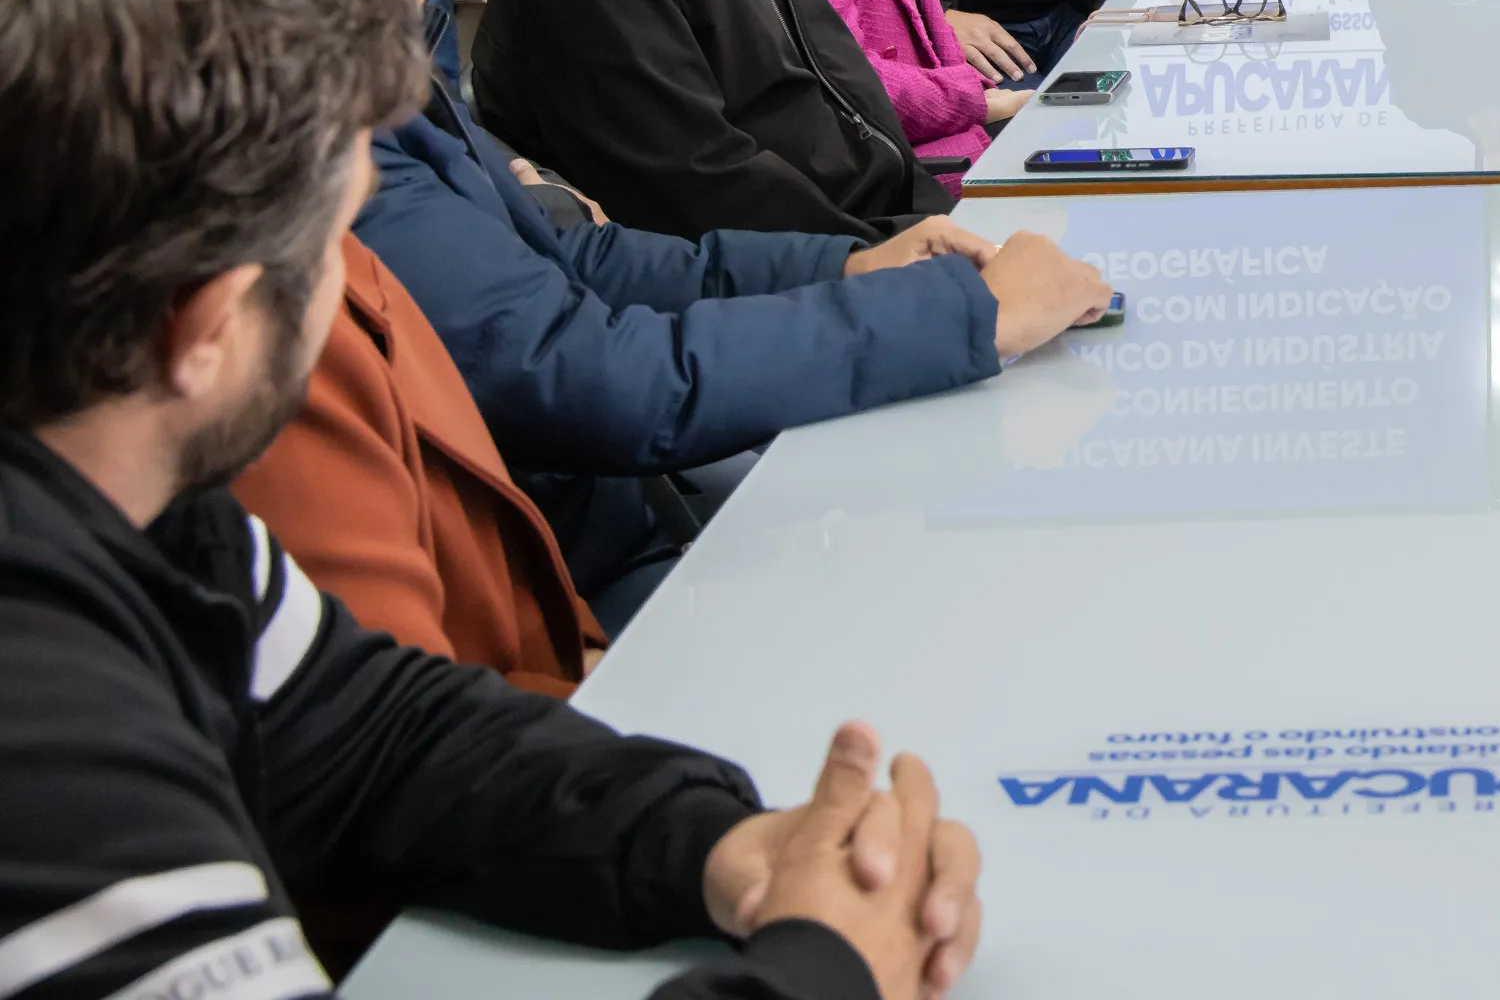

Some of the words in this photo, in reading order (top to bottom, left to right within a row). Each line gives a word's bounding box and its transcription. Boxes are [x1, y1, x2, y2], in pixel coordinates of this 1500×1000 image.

[1106, 730, 1233, 746] futuro
[1242, 730, 1269, 742] o
[1087, 745, 1253, 764] pessoas
[1263, 746, 1334, 761] das
[1089, 805, 1151, 821] DE
